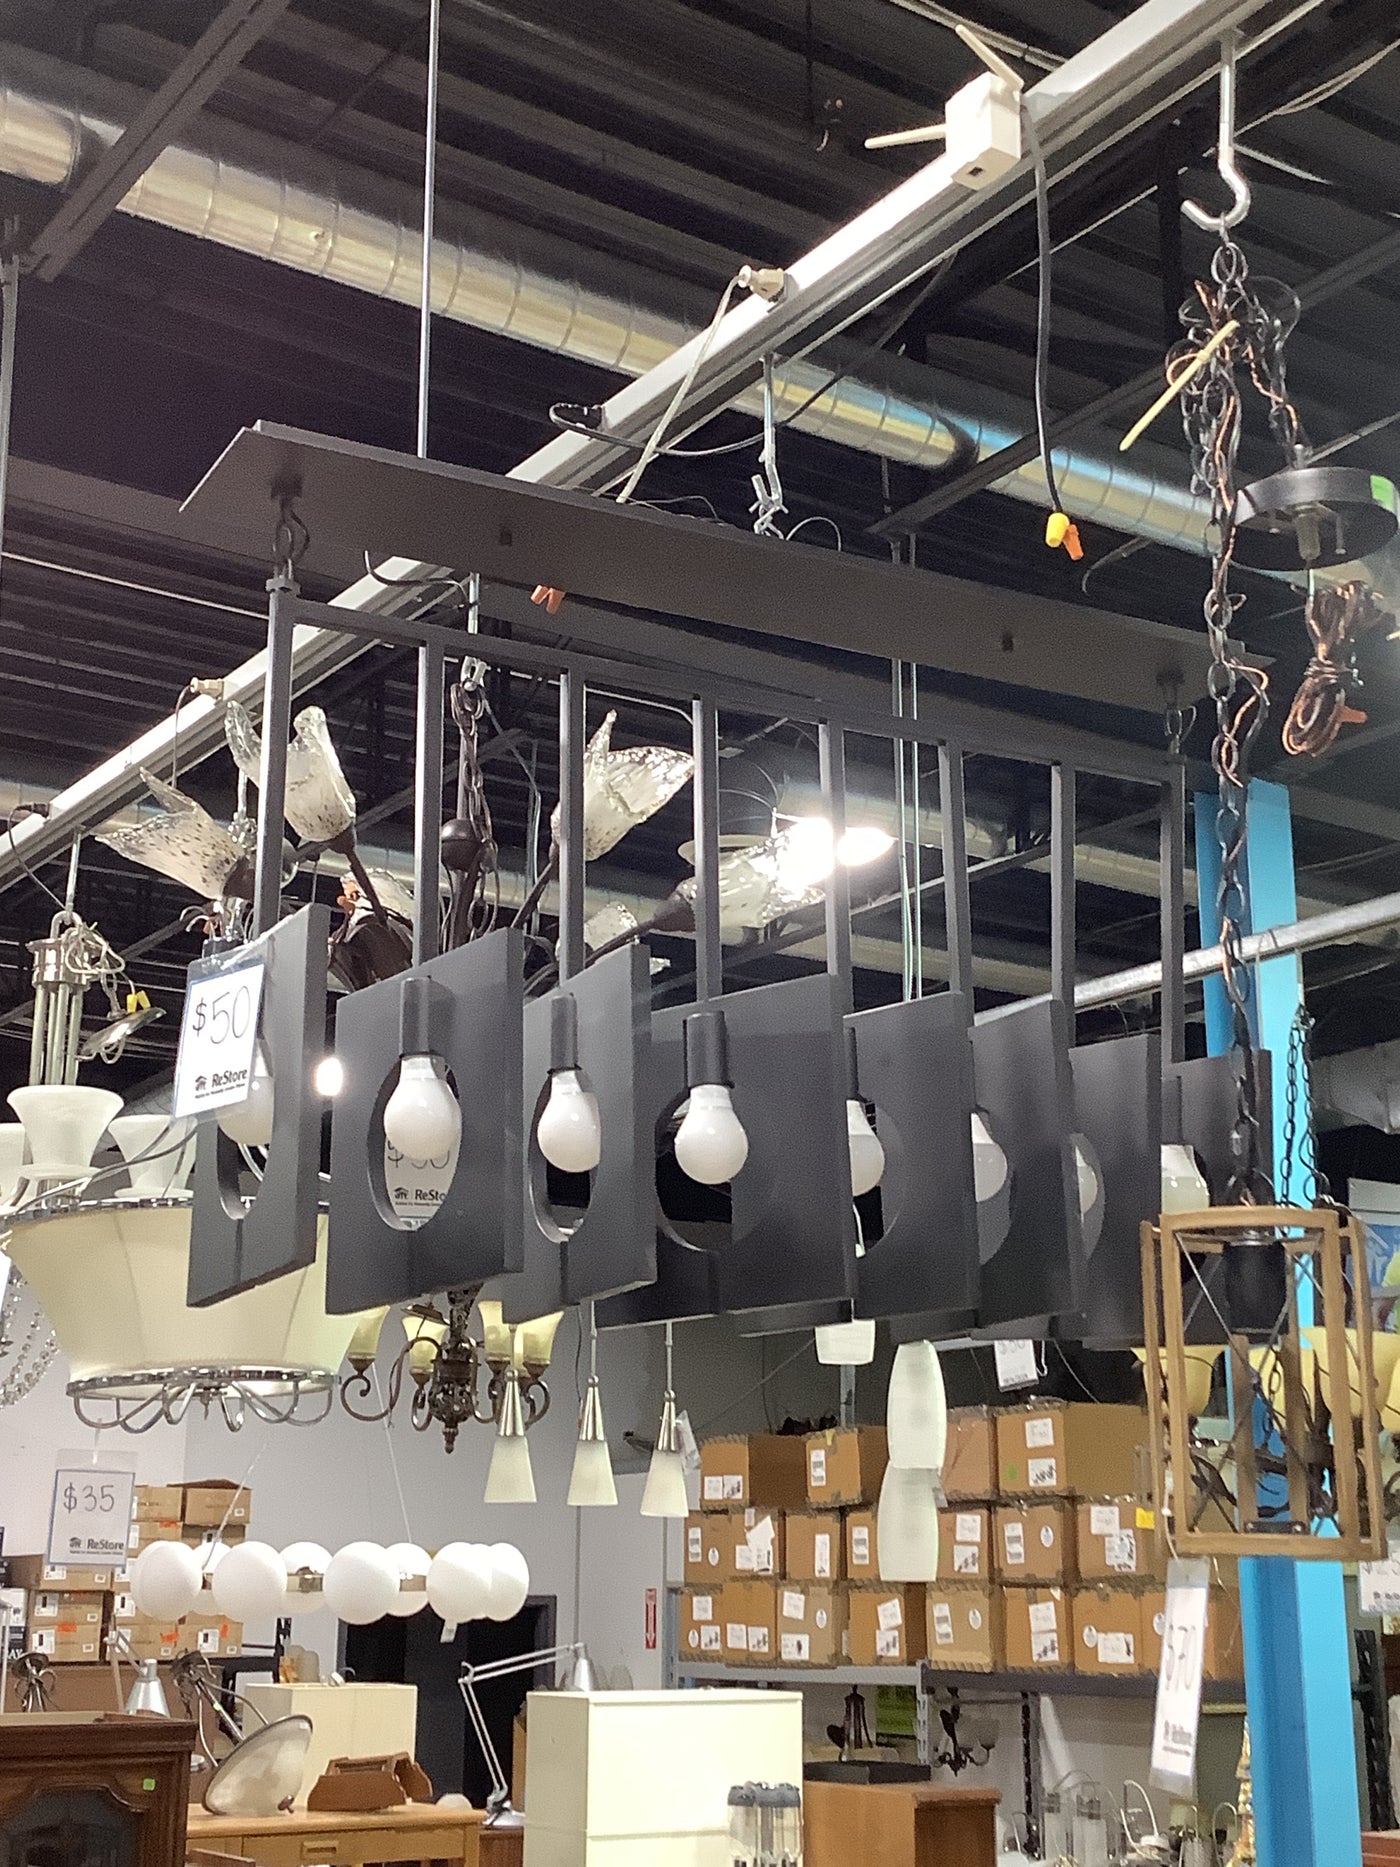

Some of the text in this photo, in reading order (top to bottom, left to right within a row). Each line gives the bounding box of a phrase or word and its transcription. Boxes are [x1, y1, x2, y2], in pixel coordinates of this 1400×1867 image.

[192, 985, 251, 1045] $50
[211, 1069, 248, 1088] ReStore
[414, 1188, 446, 1201] ReSto
[63, 1482, 116, 1514] $35
[87, 1538, 125, 1550] ReStore
